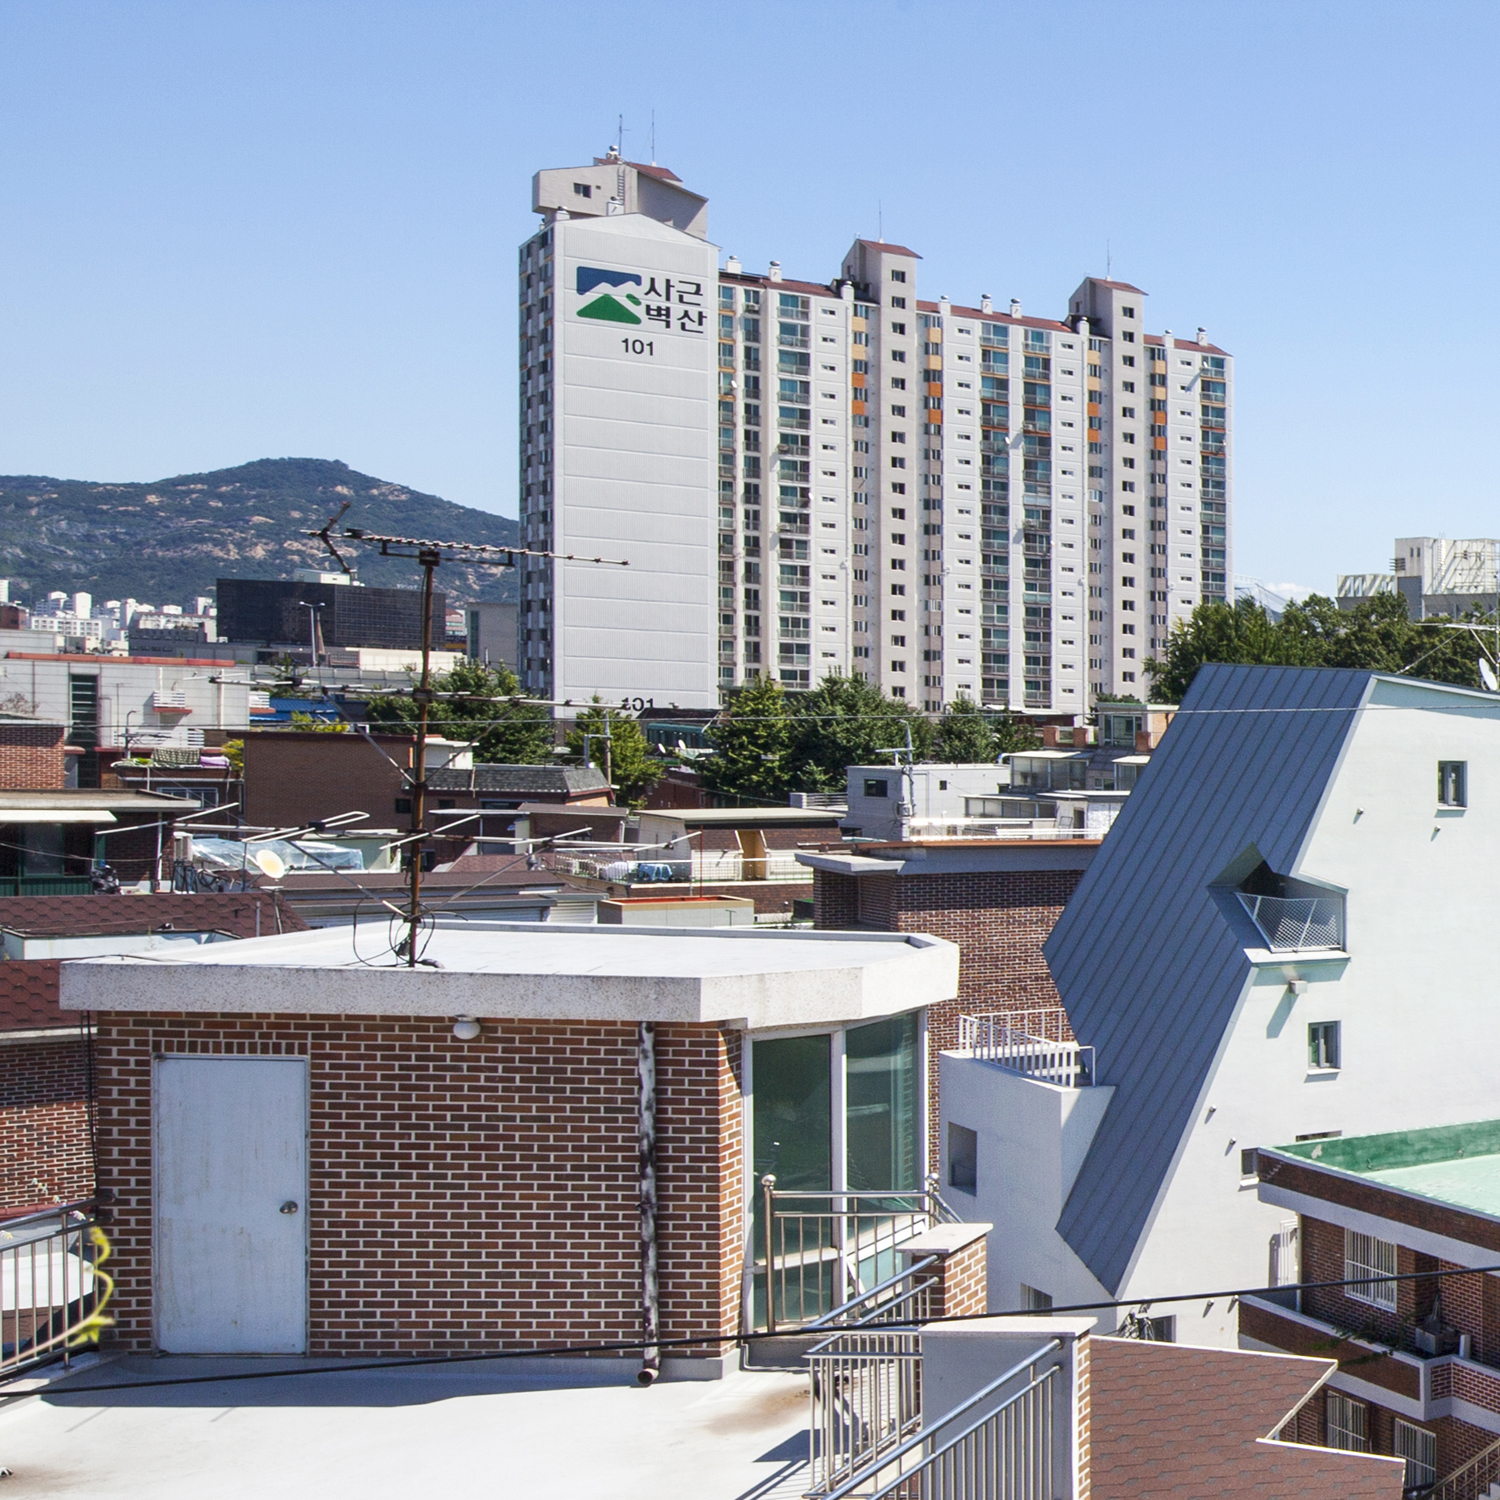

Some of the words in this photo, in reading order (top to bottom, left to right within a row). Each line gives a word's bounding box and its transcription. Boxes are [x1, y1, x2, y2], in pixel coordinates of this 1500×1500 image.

[644, 277, 703, 306] 사근
[645, 304, 707, 334] 벽산
[621, 338, 654, 356] 101
